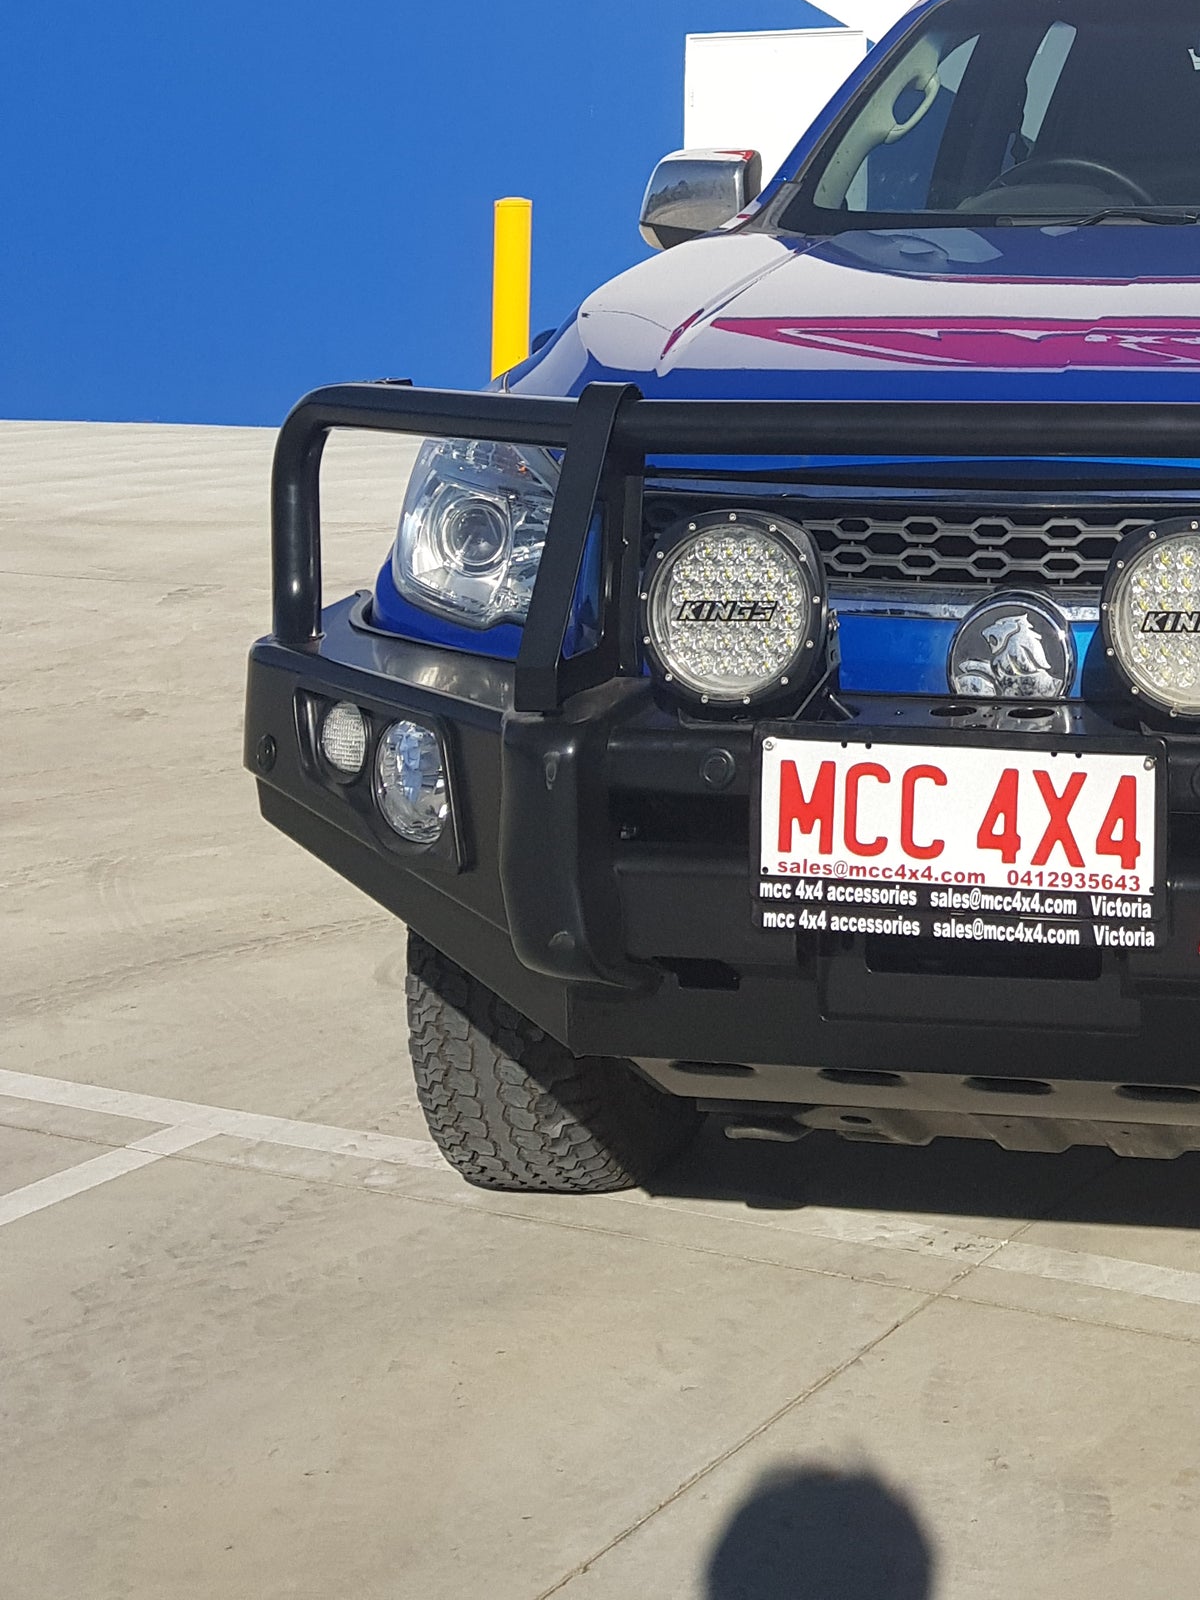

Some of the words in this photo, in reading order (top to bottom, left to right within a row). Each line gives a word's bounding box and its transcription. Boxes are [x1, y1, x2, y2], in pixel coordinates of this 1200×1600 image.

[676, 600, 779, 622] KINGS
[777, 759, 948, 860] MCC
[976, 768, 1141, 871] 4X4
[777, 859, 986, 885] sales@mcc4x4.com
[1006, 869, 1141, 892] 0412935643
[759, 883, 792, 900] mcc
[794, 879, 824, 901] 4x4
[826, 884, 918, 906] accessories
[930, 888, 1078, 915] sales@mcc4x4.com
[1090, 895, 1152, 919] Victoria
[762, 912, 795, 928] mcc
[798, 909, 827, 931] 4x4
[830, 915, 921, 937] accessories
[932, 918, 1080, 945] sales@mcc4x4.com
[1092, 924, 1156, 948] Victoria
